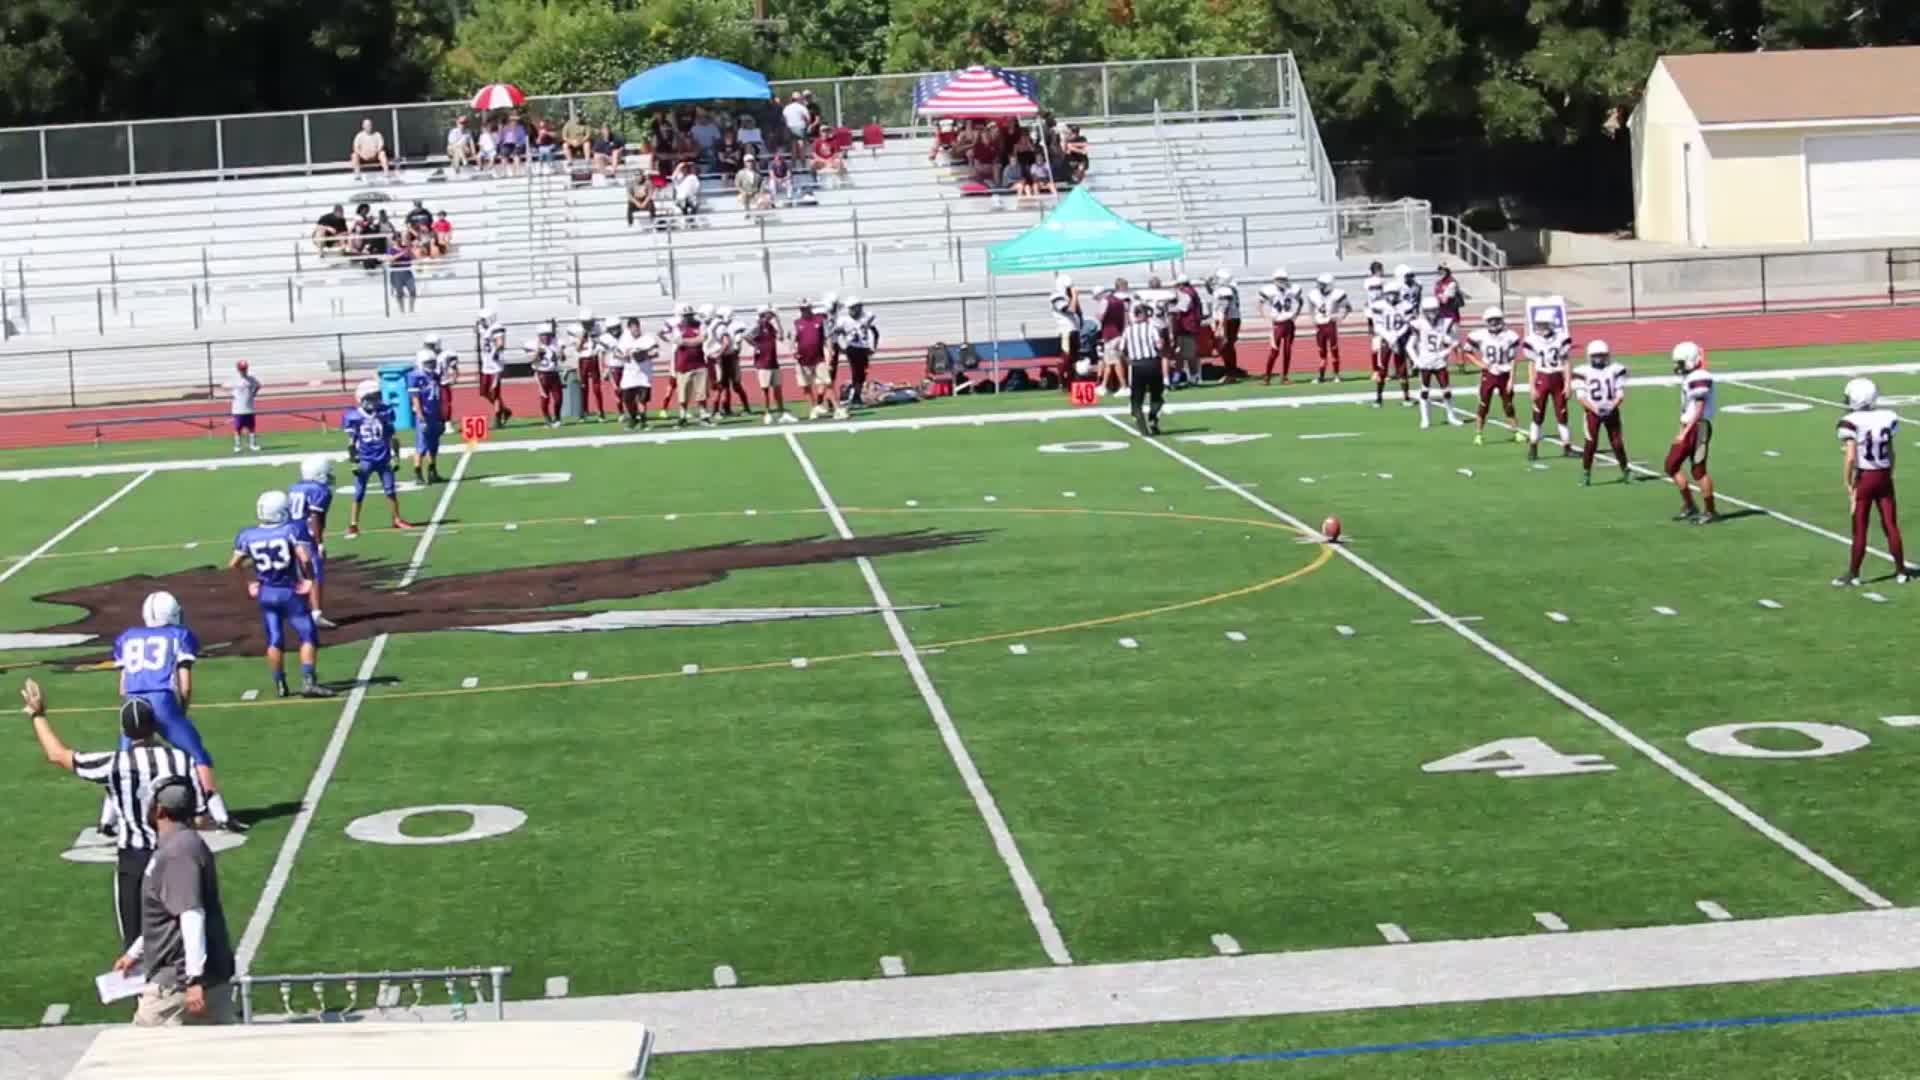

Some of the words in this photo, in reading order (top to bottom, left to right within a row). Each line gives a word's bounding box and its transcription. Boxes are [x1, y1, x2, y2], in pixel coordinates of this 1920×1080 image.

[1538, 348, 1560, 368] 13
[1075, 383, 1095, 406] 40
[1589, 378, 1614, 401] 21
[465, 417, 485, 439] 50
[1863, 427, 1892, 462] 12
[249, 537, 291, 572] 53
[122, 636, 168, 673] 83
